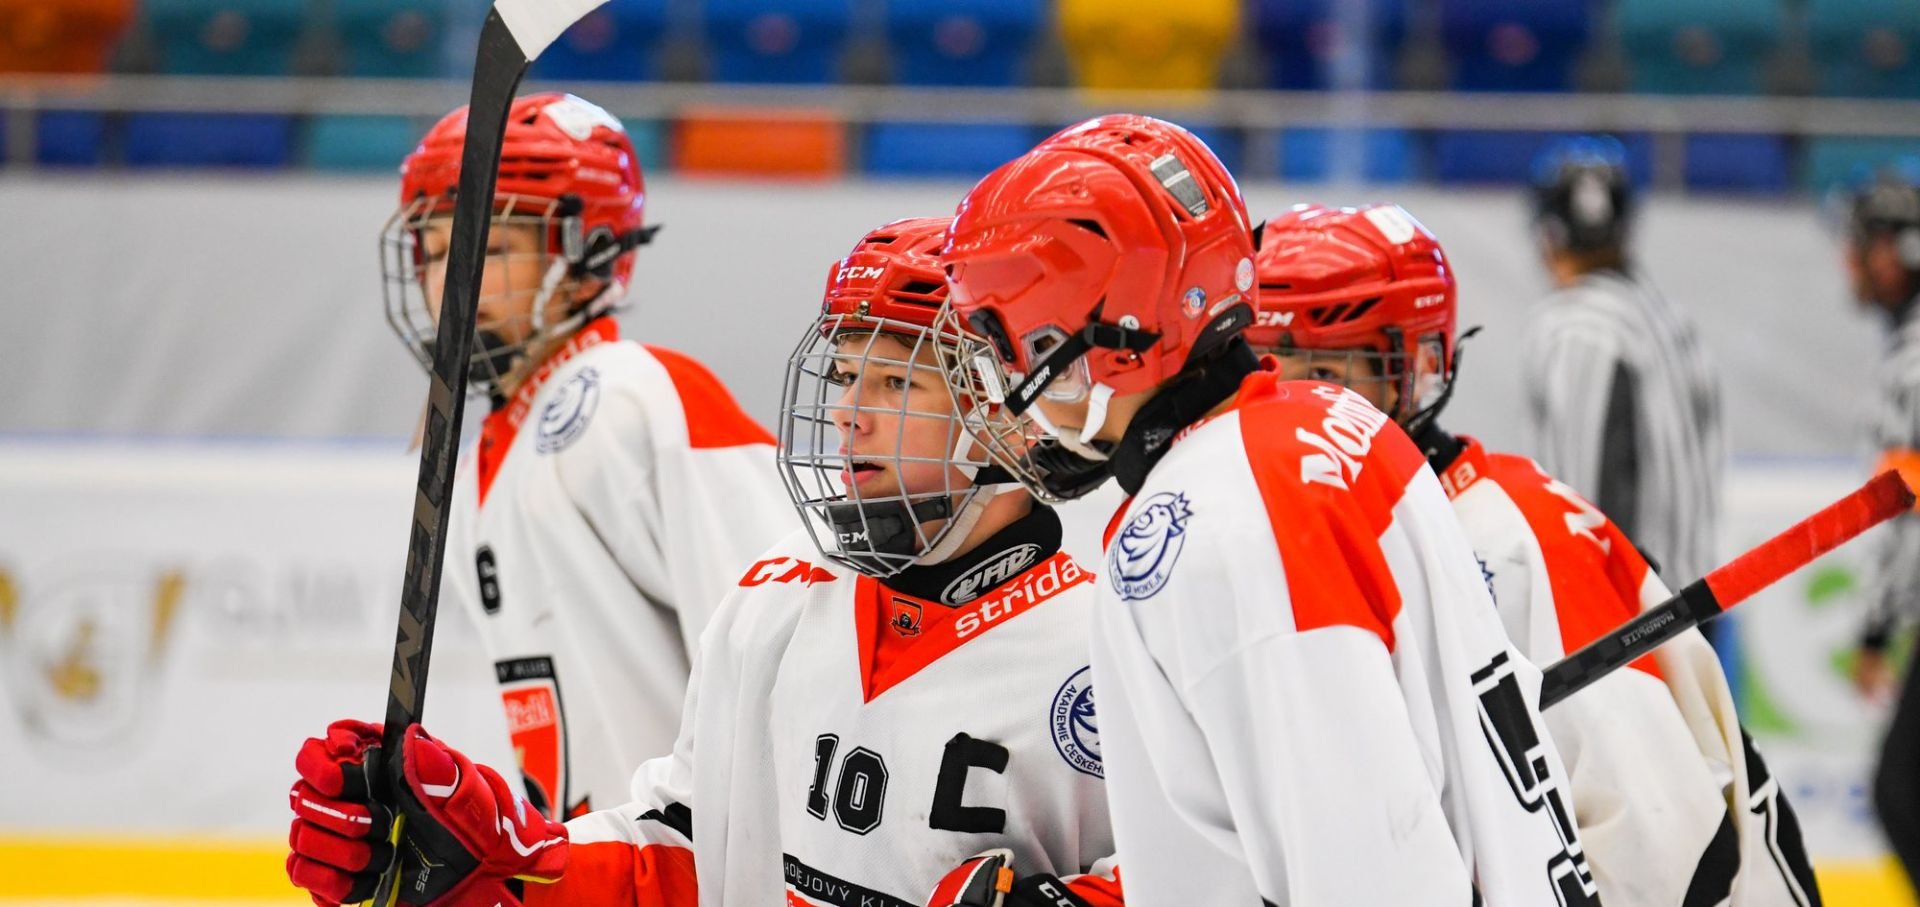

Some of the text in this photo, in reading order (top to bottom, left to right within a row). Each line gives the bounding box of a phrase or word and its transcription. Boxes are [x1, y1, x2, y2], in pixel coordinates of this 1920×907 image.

[836, 266, 885, 283] CCM
[1257, 311, 1295, 327] CM
[1021, 365, 1051, 402] BAUER
[954, 557, 1082, 640] střída
[1056, 683, 1077, 743] AKADEMIE
[806, 733, 889, 836] 10
[929, 731, 1010, 834] C
[784, 860, 850, 901] HOEJOVÝ
